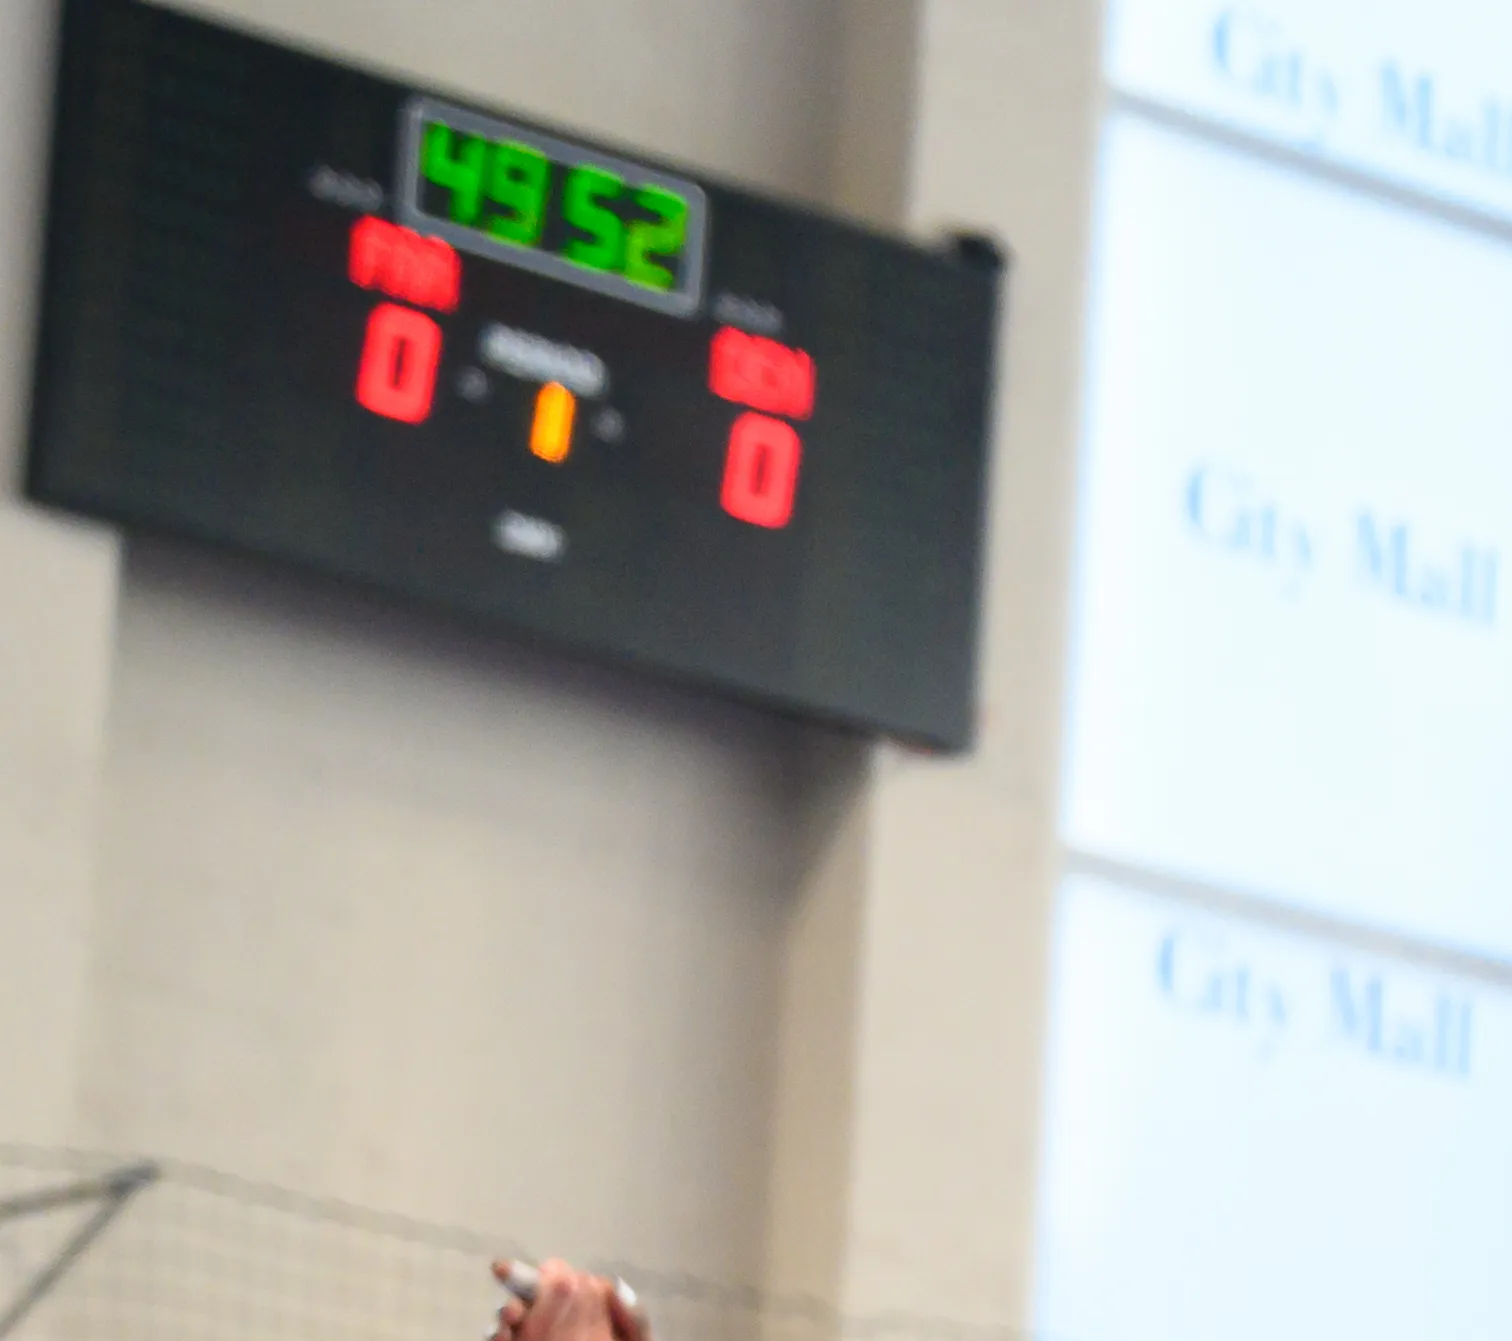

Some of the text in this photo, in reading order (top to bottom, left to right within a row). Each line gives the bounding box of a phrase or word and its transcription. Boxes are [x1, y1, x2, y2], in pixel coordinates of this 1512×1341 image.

[1209, 7, 1341, 152] City
[354, 300, 444, 427] 0
[718, 410, 803, 531] 0
[1182, 460, 1501, 628] City Mall
[1155, 924, 1478, 1082] City Mall
